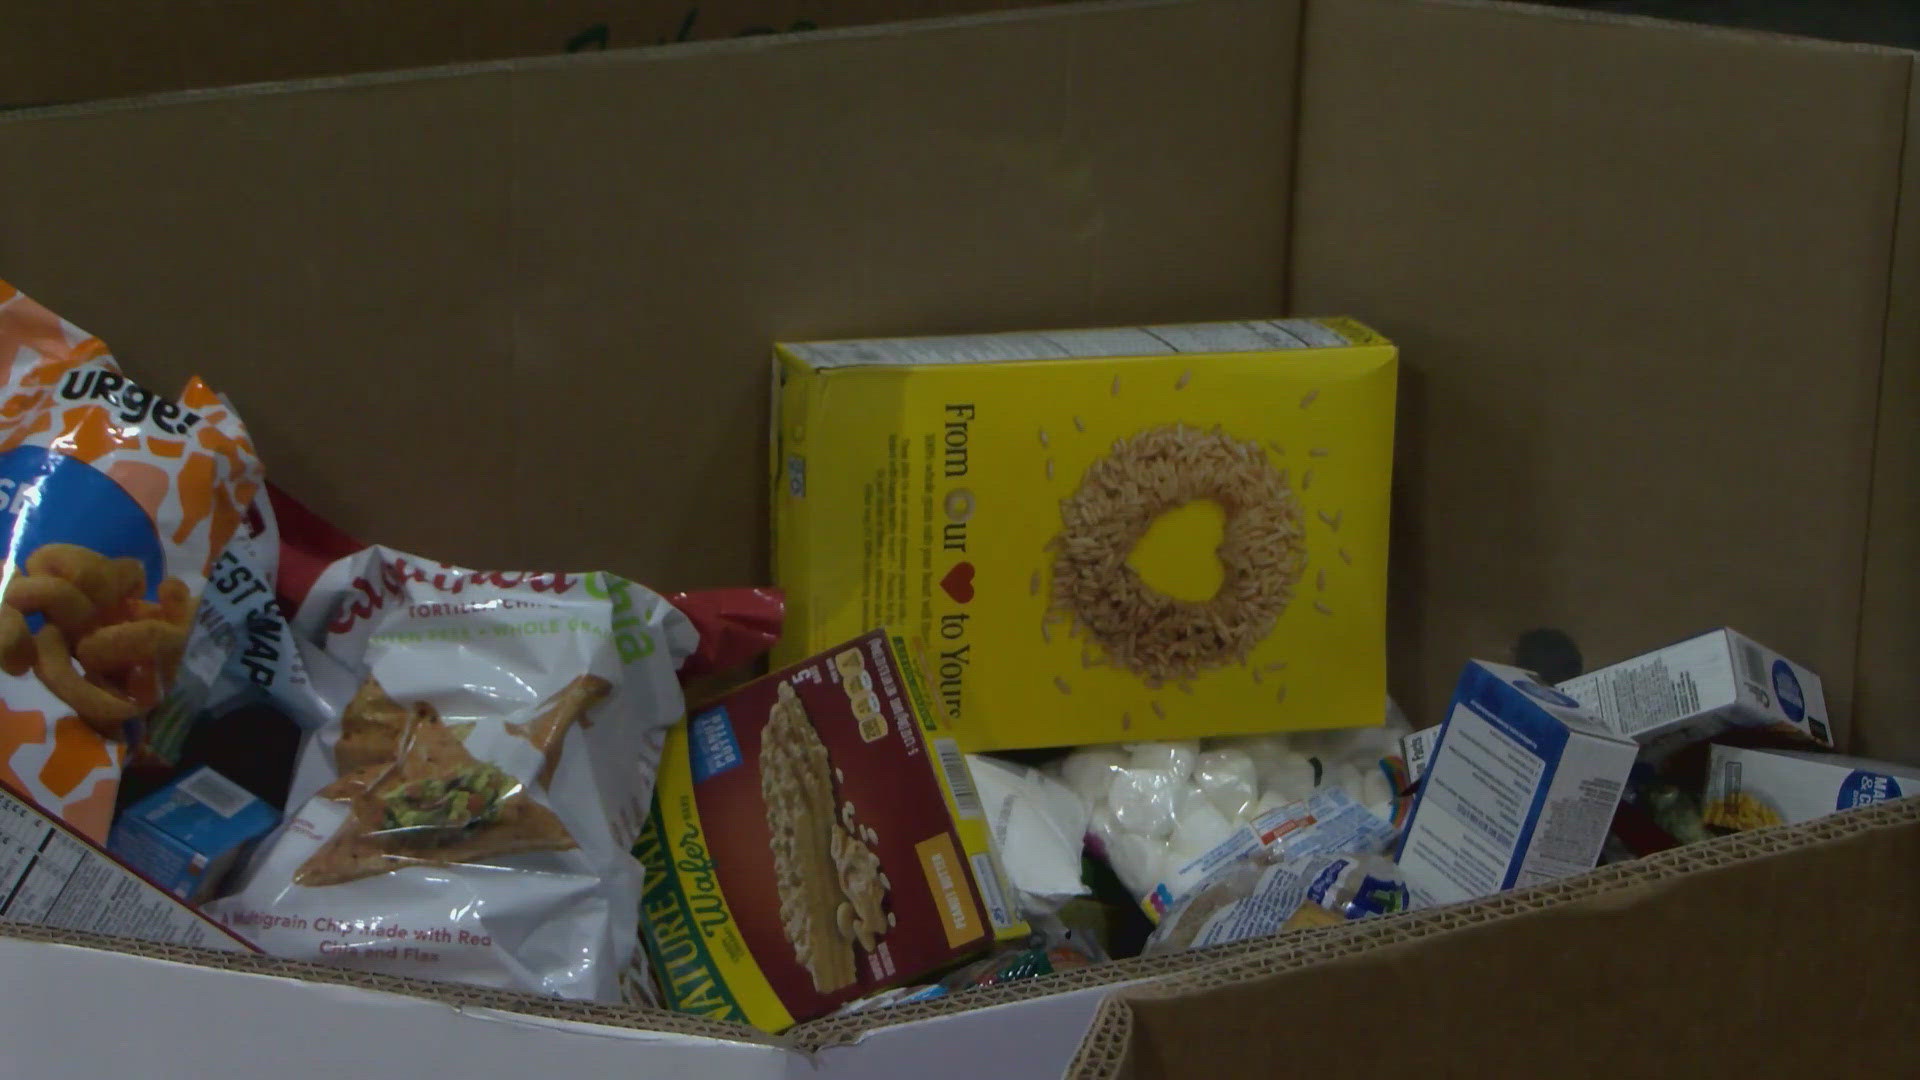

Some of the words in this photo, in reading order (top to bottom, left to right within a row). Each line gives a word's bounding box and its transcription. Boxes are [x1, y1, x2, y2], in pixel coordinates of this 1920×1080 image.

[944, 403, 975, 477] From
[409, 599, 497, 618] TORTILL
[495, 618, 560, 637] WHOLE
[940, 612, 970, 641] to
[939, 644, 971, 719] Yours
[1861, 775, 1874, 791] &
[1872, 776, 1888, 801] MA
[678, 823, 729, 938] Wafer
[232, 910, 307, 930] Multigrain
[313, 917, 354, 937] Chip
[360, 921, 407, 940] made
[413, 926, 451, 944] with
[363, 946, 399, 961] and
